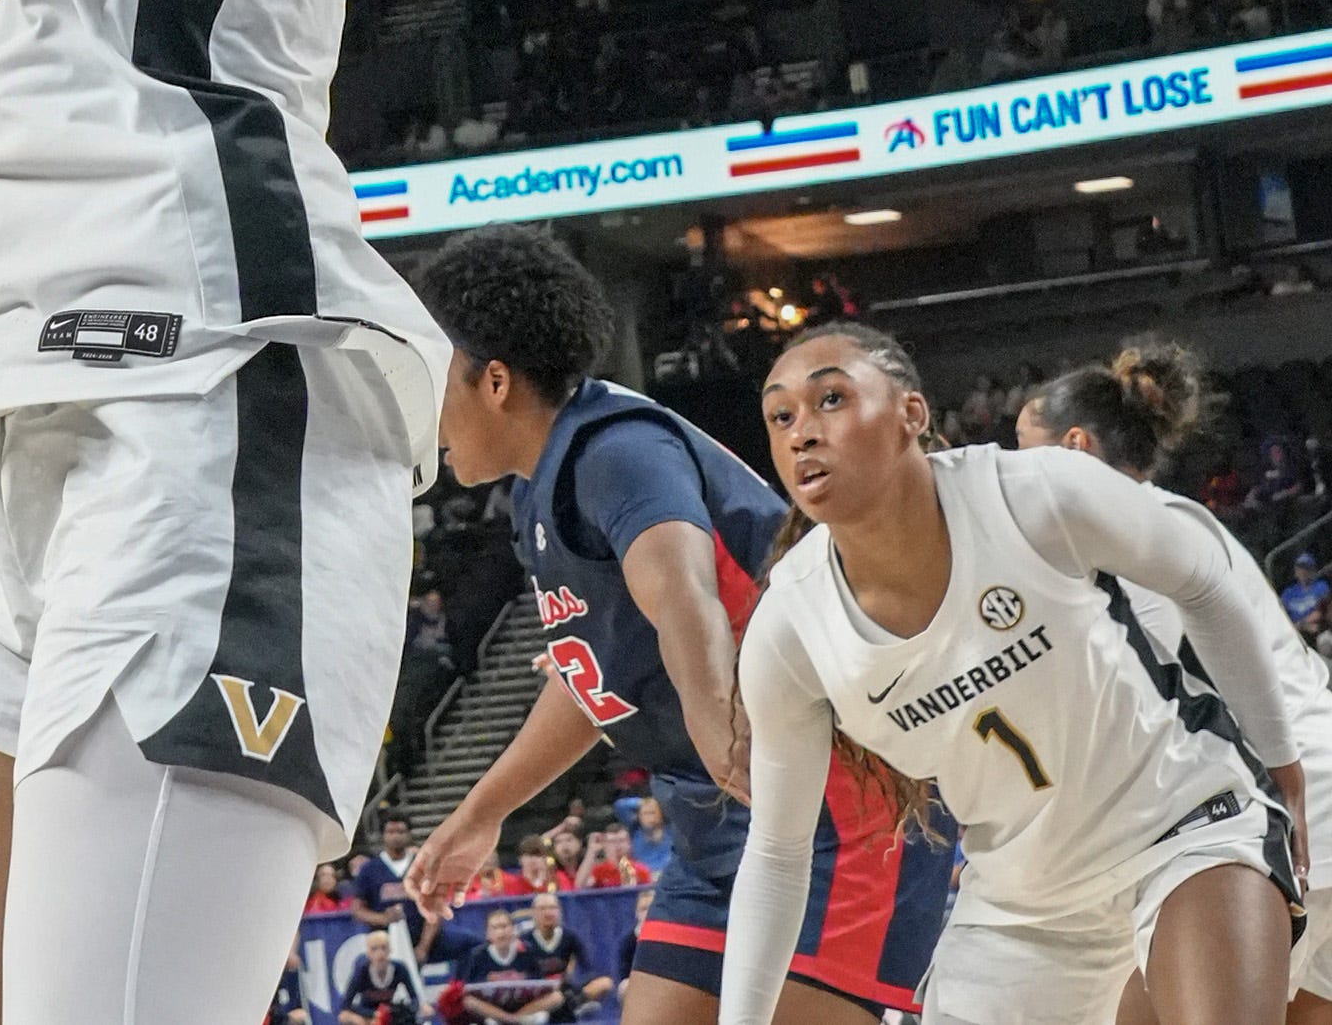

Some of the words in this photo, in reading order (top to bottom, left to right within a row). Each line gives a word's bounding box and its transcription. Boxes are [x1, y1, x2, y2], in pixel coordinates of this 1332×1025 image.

[933, 101, 1002, 146] FUN
[1009, 82, 1112, 135] CAN'T
[1121, 67, 1214, 116] LOSE
[448, 153, 684, 205] Academy.com
[133, 323, 158, 342] 48
[979, 586, 1023, 631] SEC
[209, 673, 305, 763] V
[547, 635, 639, 726] 2
[887, 625, 1053, 732] VANDERBILT
[972, 706, 1053, 792] 1
[1211, 802, 1228, 817] 44
